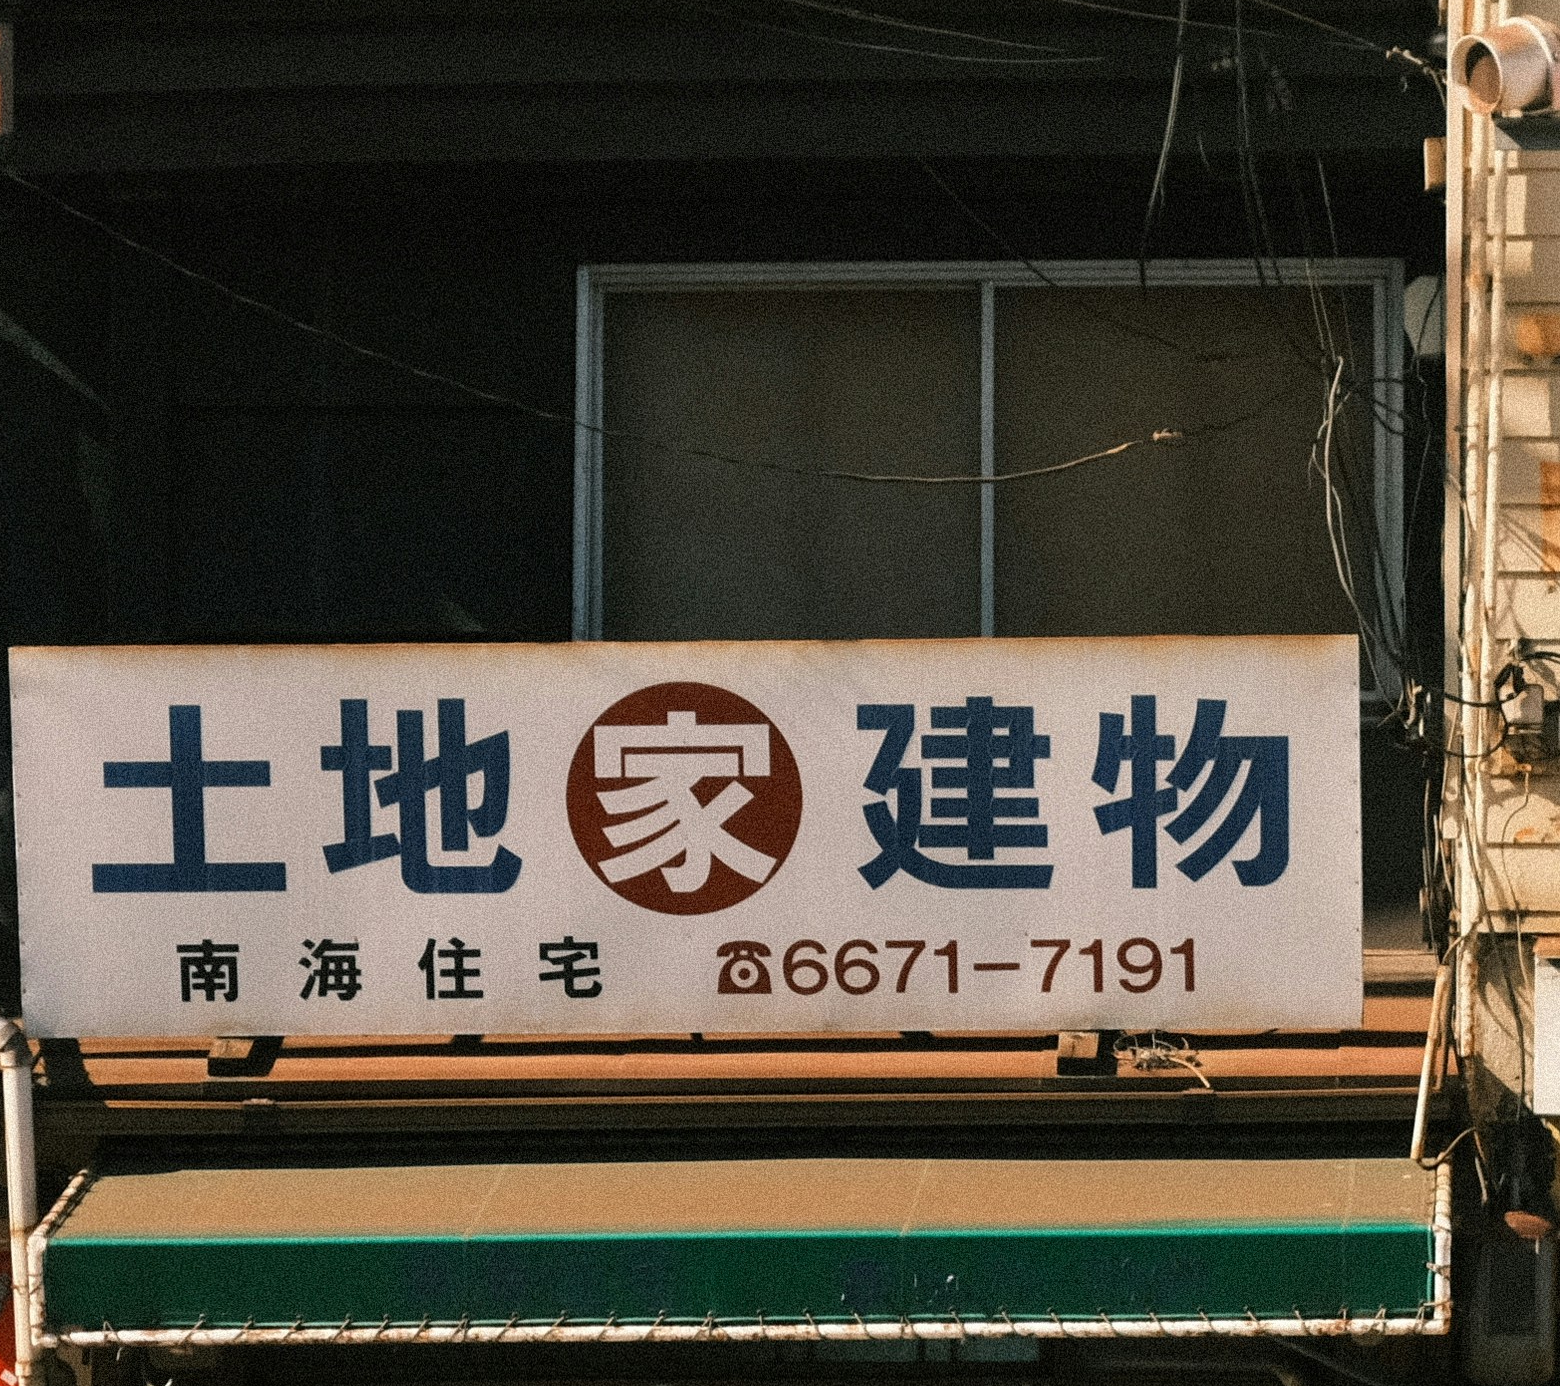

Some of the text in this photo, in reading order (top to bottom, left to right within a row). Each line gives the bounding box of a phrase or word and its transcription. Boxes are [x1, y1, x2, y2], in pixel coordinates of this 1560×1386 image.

[92, 693, 1291, 894] 土地 家 建物
[175, 935, 604, 1002] 南海住宅
